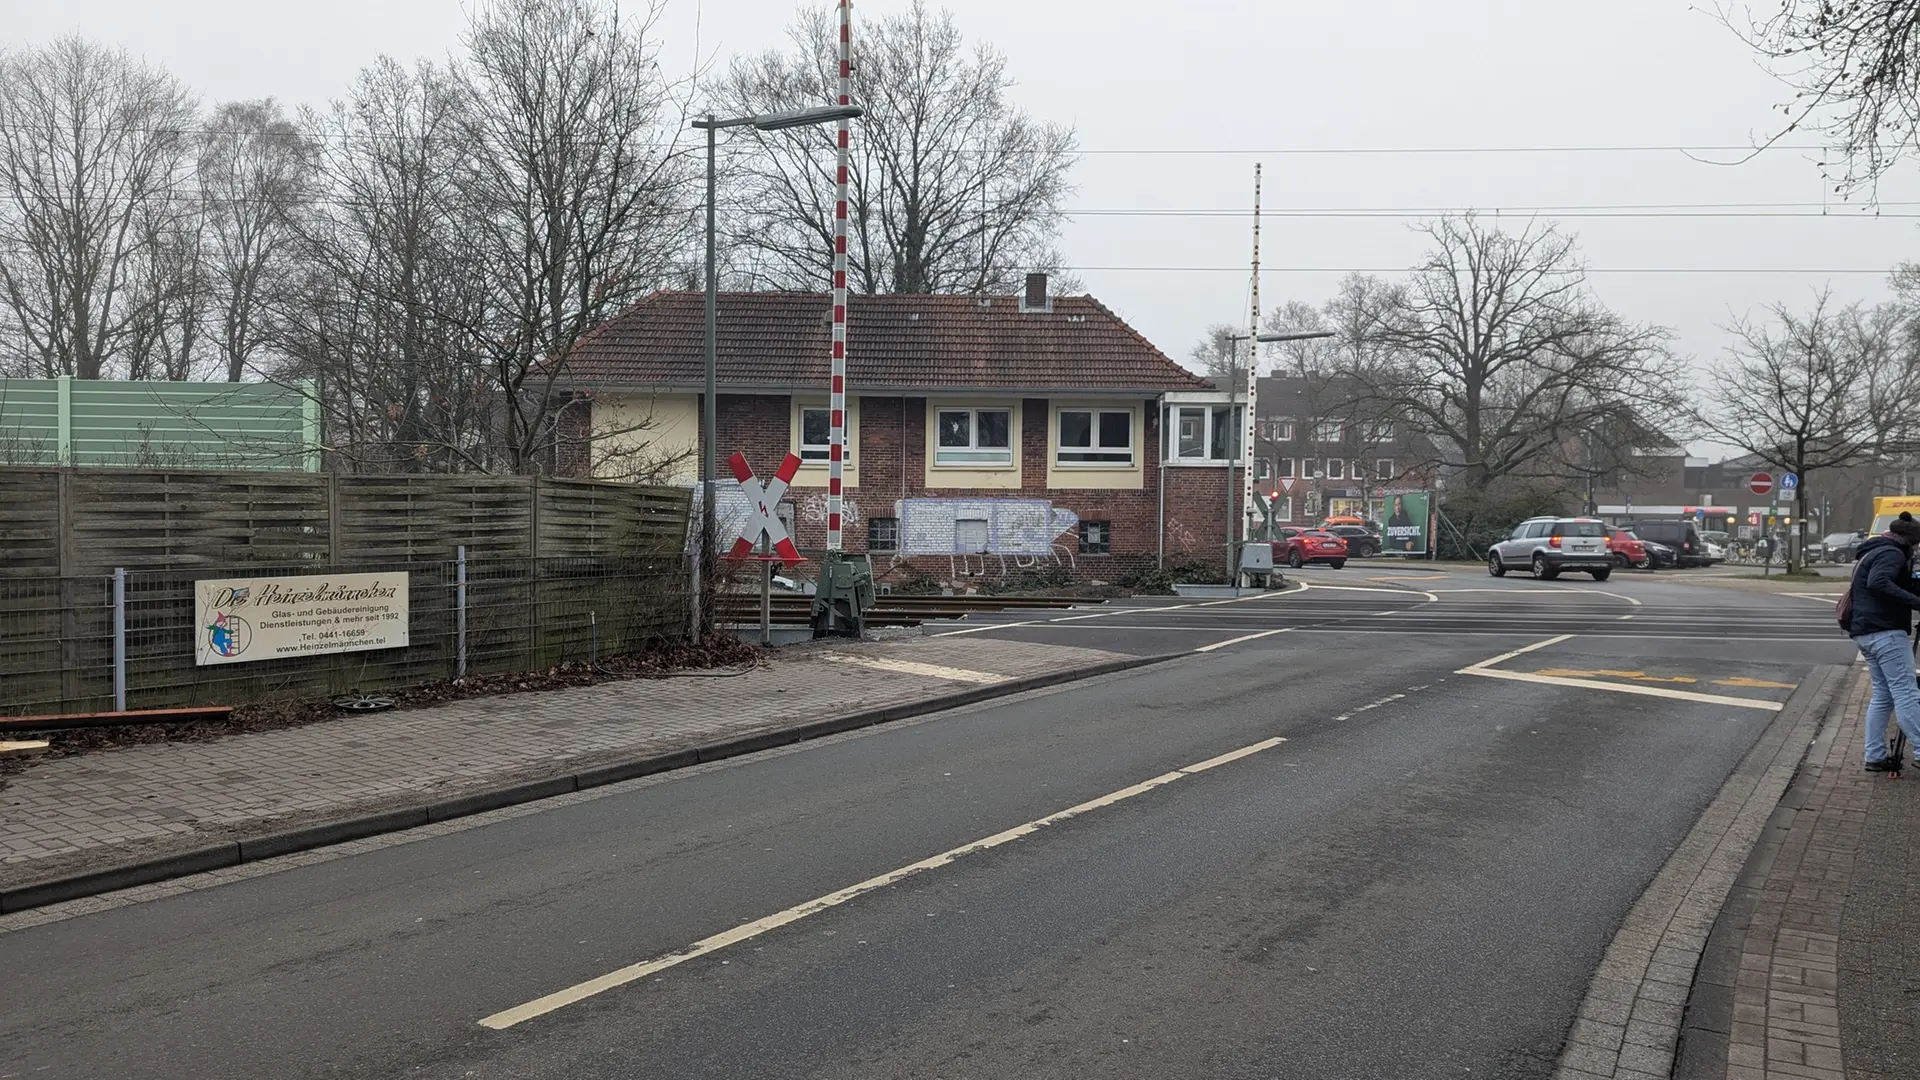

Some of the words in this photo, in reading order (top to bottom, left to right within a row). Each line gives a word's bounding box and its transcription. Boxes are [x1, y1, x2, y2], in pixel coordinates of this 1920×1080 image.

[1387, 526, 1421, 536] ZUVERSICHT.
[253, 580, 397, 607] Heinzelmännchen
[271, 609, 294, 618] Glas-
[297, 608, 313, 617] und
[315, 605, 389, 616] Gebäudereinigung
[260, 617, 332, 629] Dienstleistungen
[334, 616, 340, 624] &
[342, 614, 364, 623] mehr
[365, 613, 379, 622] seit
[381, 612, 399, 621] 1992
[301, 632, 316, 641] Tel.
[318, 629, 365, 640] 0441-16659
